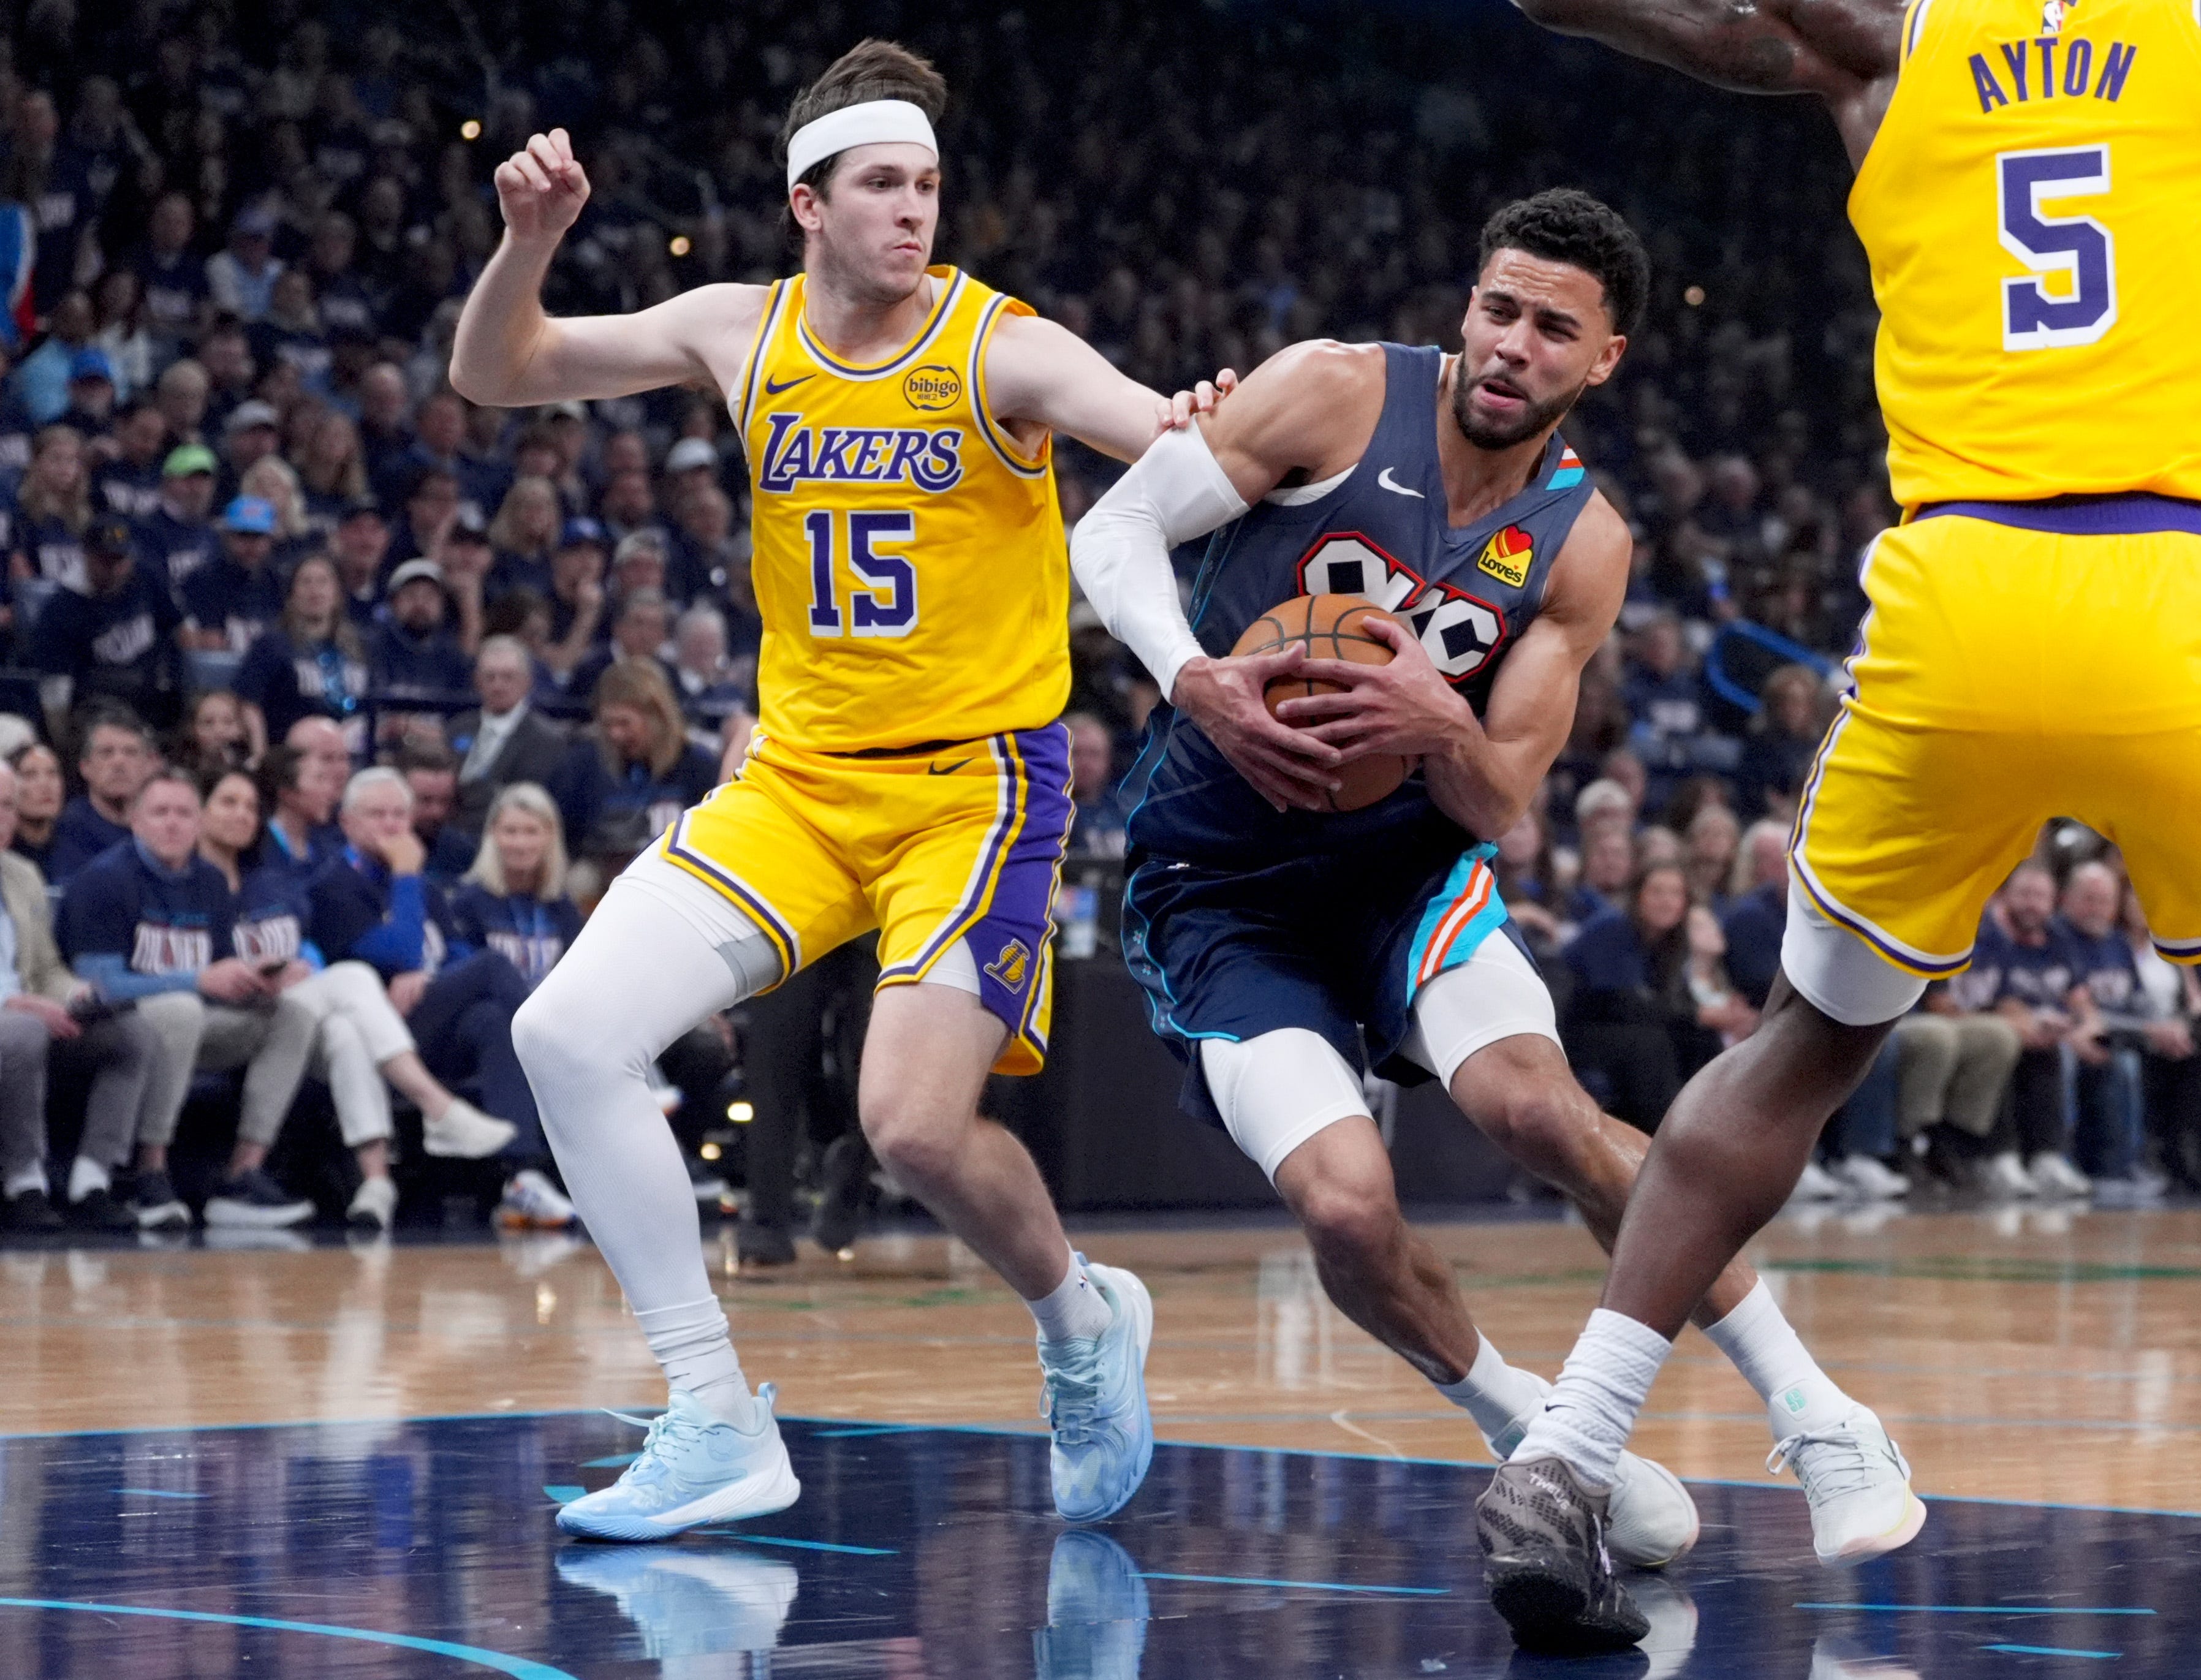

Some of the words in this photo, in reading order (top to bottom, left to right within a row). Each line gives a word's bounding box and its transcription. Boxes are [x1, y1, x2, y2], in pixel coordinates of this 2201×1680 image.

[1968, 37, 2137, 115] AYTON
[1995, 142, 2119, 352] 5
[909, 377, 958, 398] bibigo
[759, 412, 964, 494] LAKERS
[803, 509, 919, 638] 15
